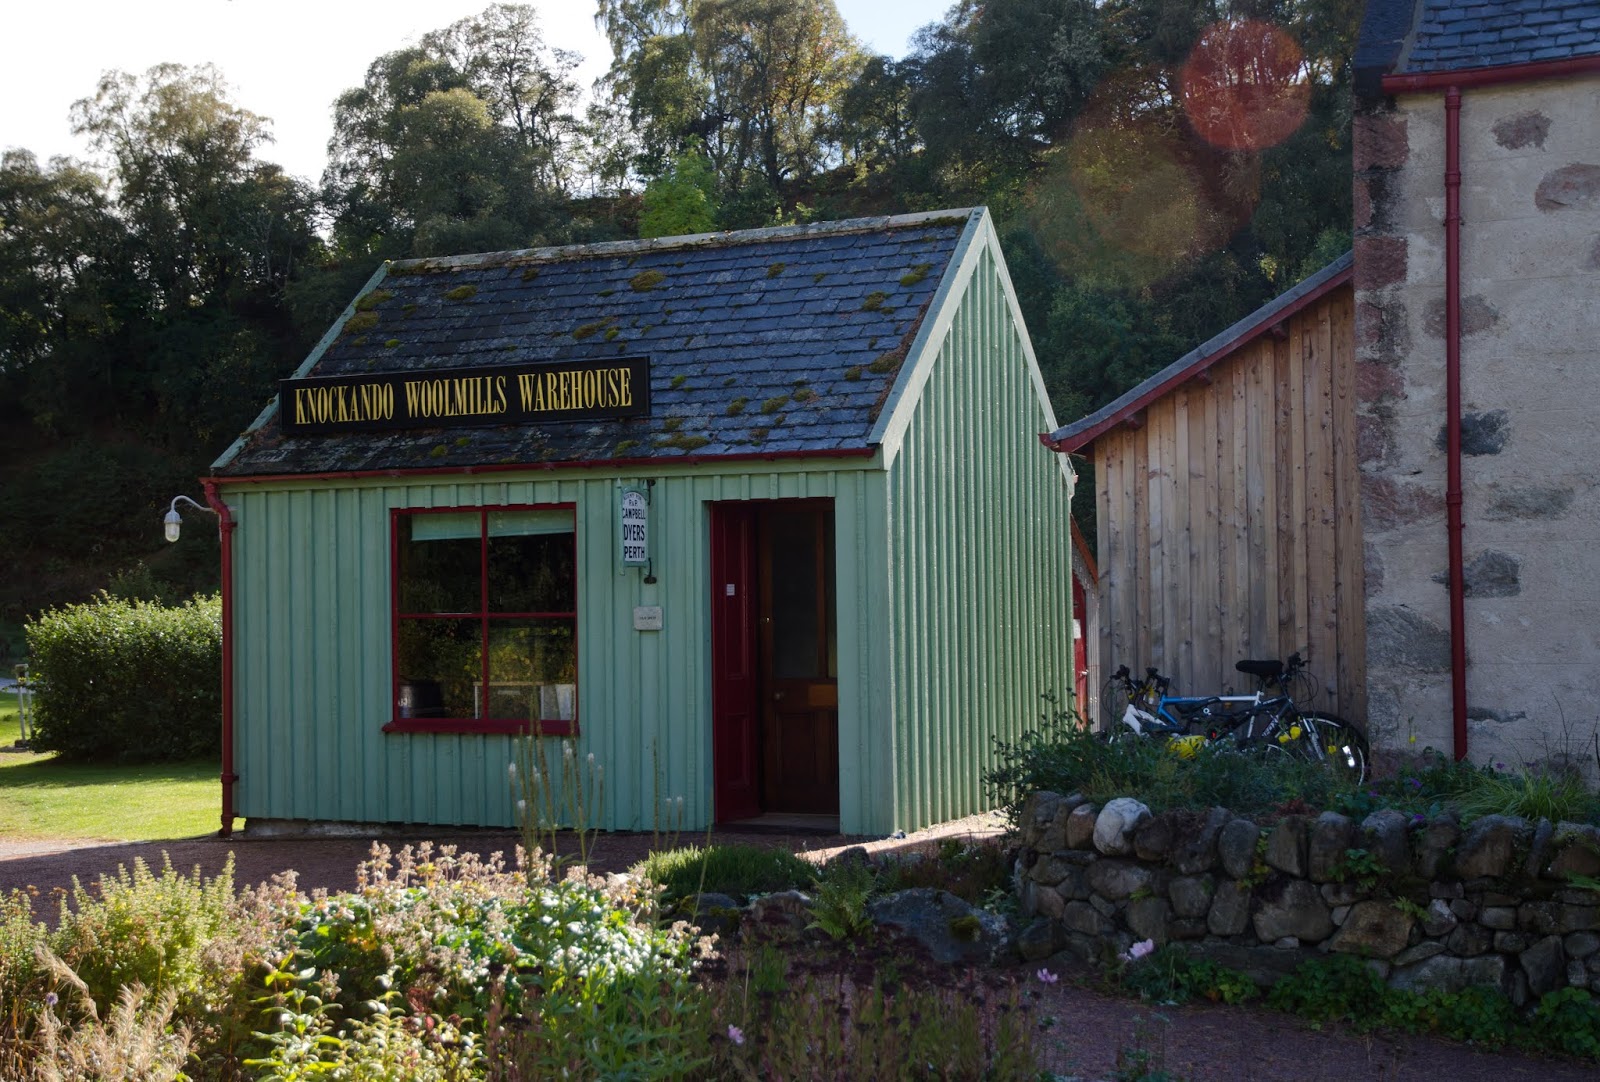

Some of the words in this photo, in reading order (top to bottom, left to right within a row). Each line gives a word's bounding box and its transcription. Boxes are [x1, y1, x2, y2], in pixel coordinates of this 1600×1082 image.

[294, 382, 394, 425] KNOCKANDO
[405, 375, 507, 418] WOOLMILLS
[518, 367, 632, 412] WAREHOUSE
[622, 508, 646, 519] CAMPBELL
[624, 524, 645, 541] DYERS
[624, 546, 645, 559] PERTH
